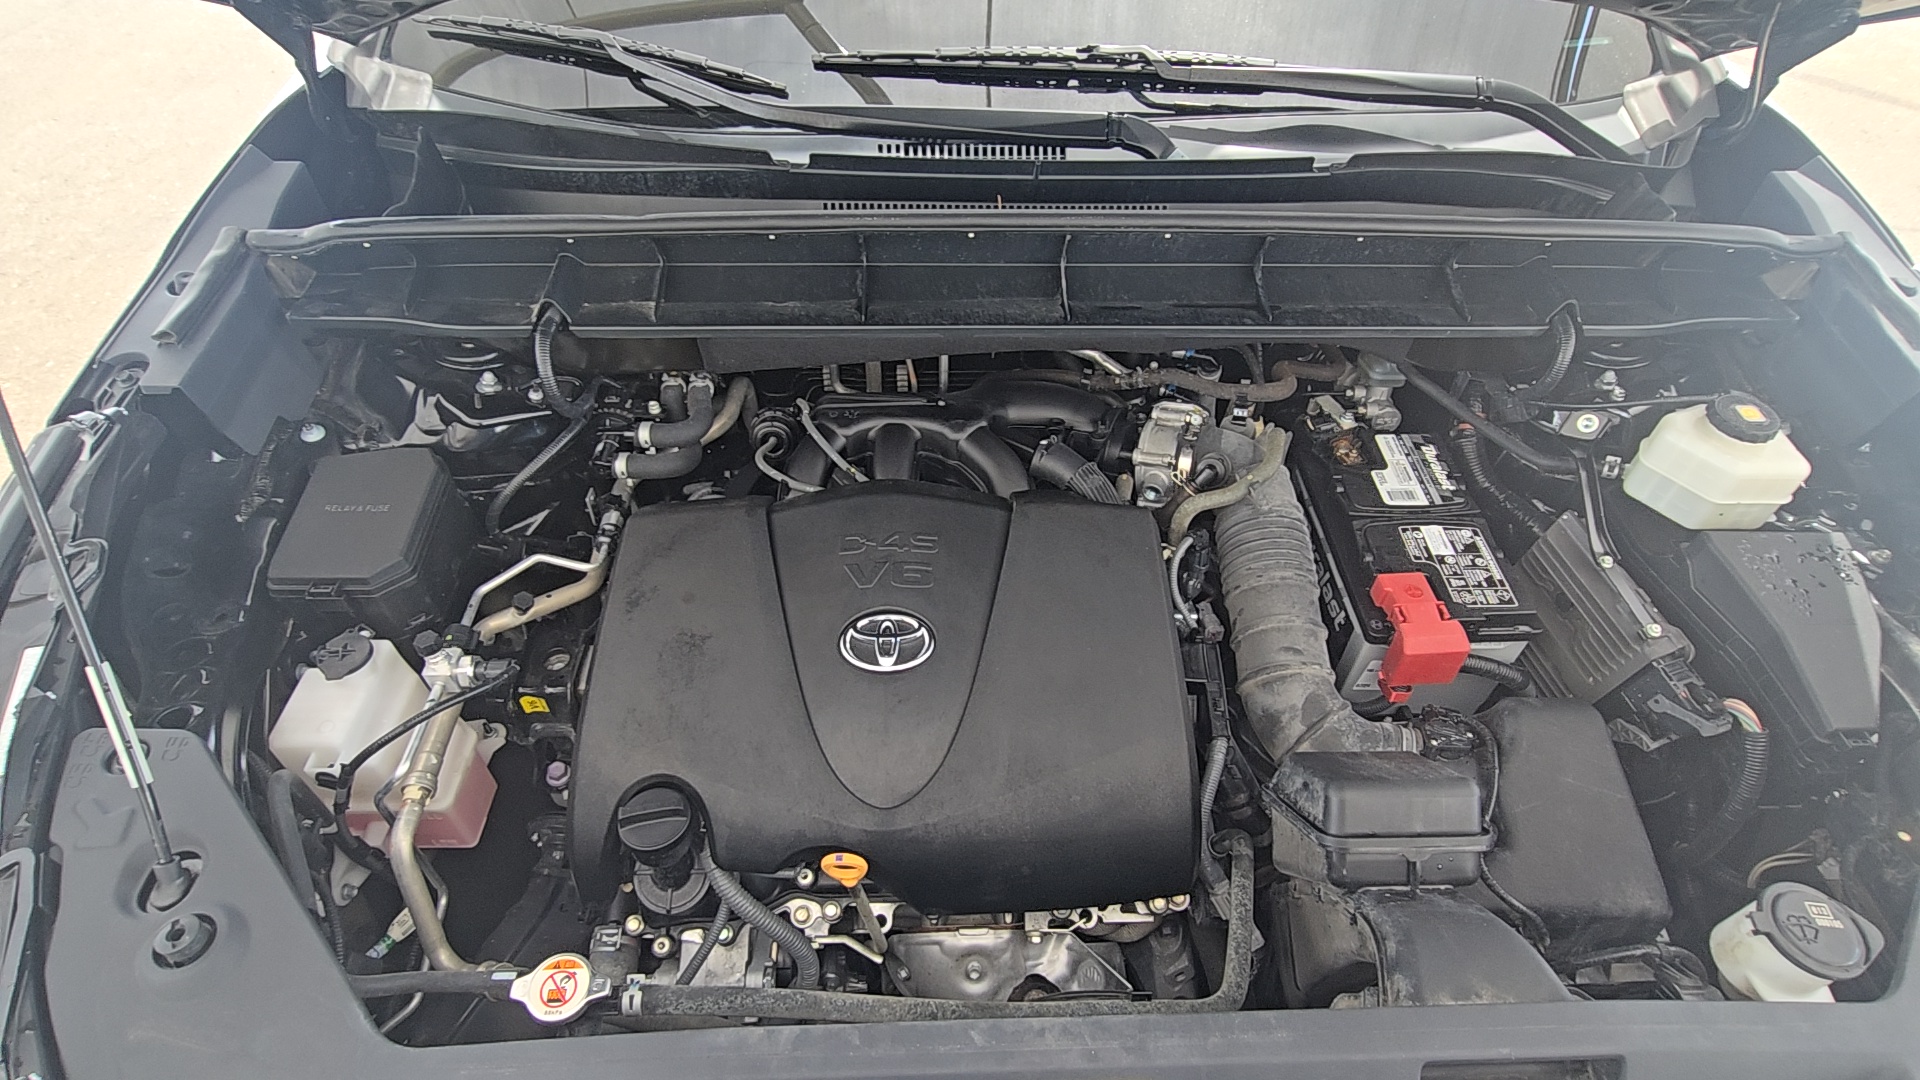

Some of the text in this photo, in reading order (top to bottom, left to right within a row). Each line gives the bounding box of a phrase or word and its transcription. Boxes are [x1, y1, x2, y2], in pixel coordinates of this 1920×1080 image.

[1420, 443, 1457, 490] Duralast
[365, 504, 391, 512] FUSE
[842, 561, 933, 589] V6
